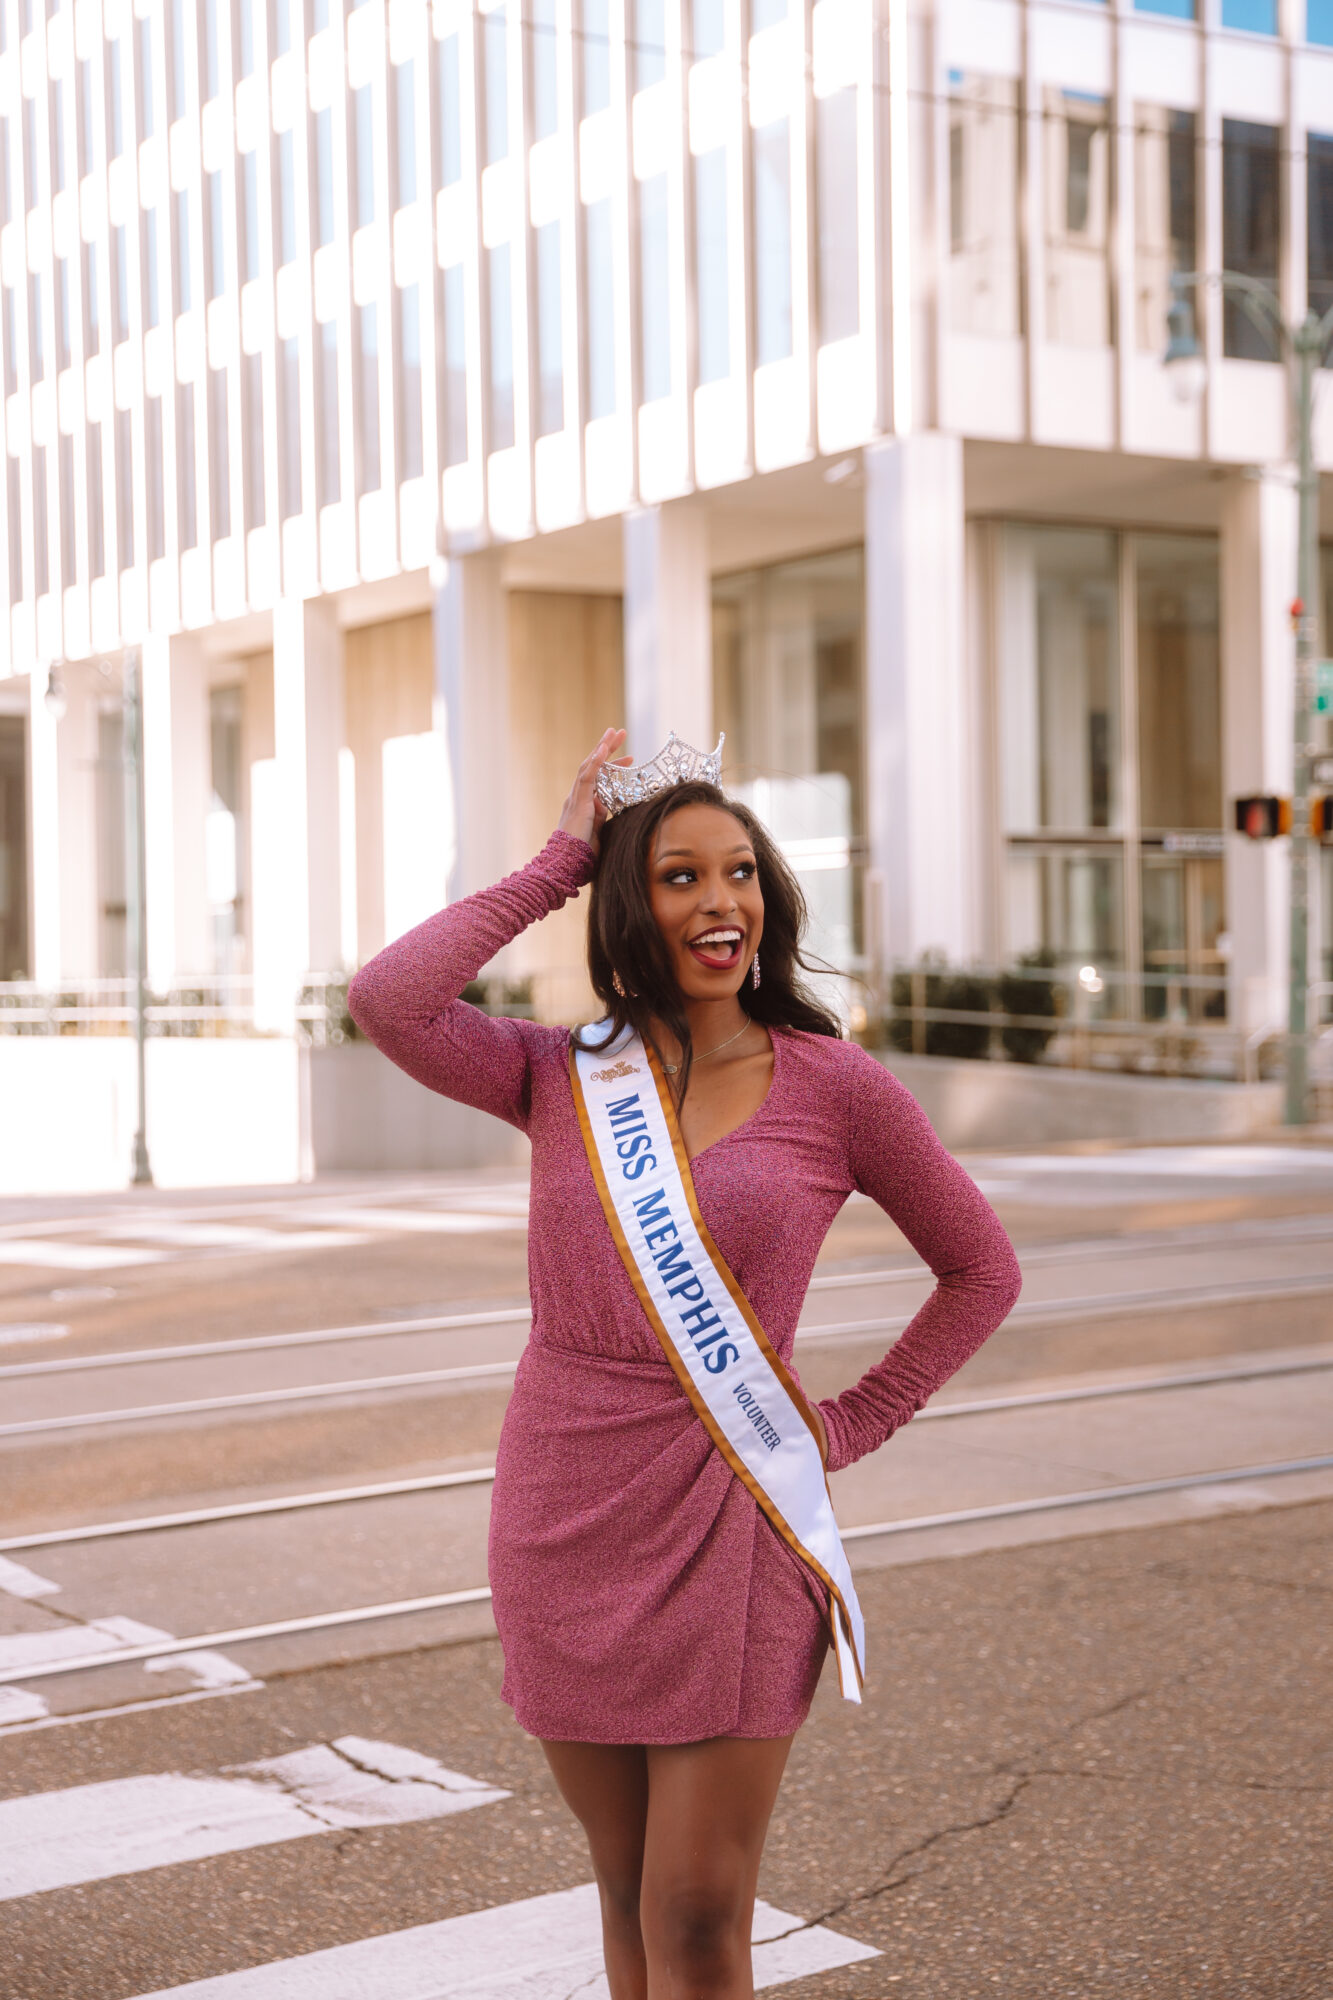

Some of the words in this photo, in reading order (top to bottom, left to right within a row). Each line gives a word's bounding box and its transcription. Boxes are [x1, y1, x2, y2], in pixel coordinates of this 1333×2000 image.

[605, 1093, 658, 1181] MISS
[631, 1187, 741, 1375] MEMPHIS
[732, 1382, 782, 1452] VOLUNTEER
